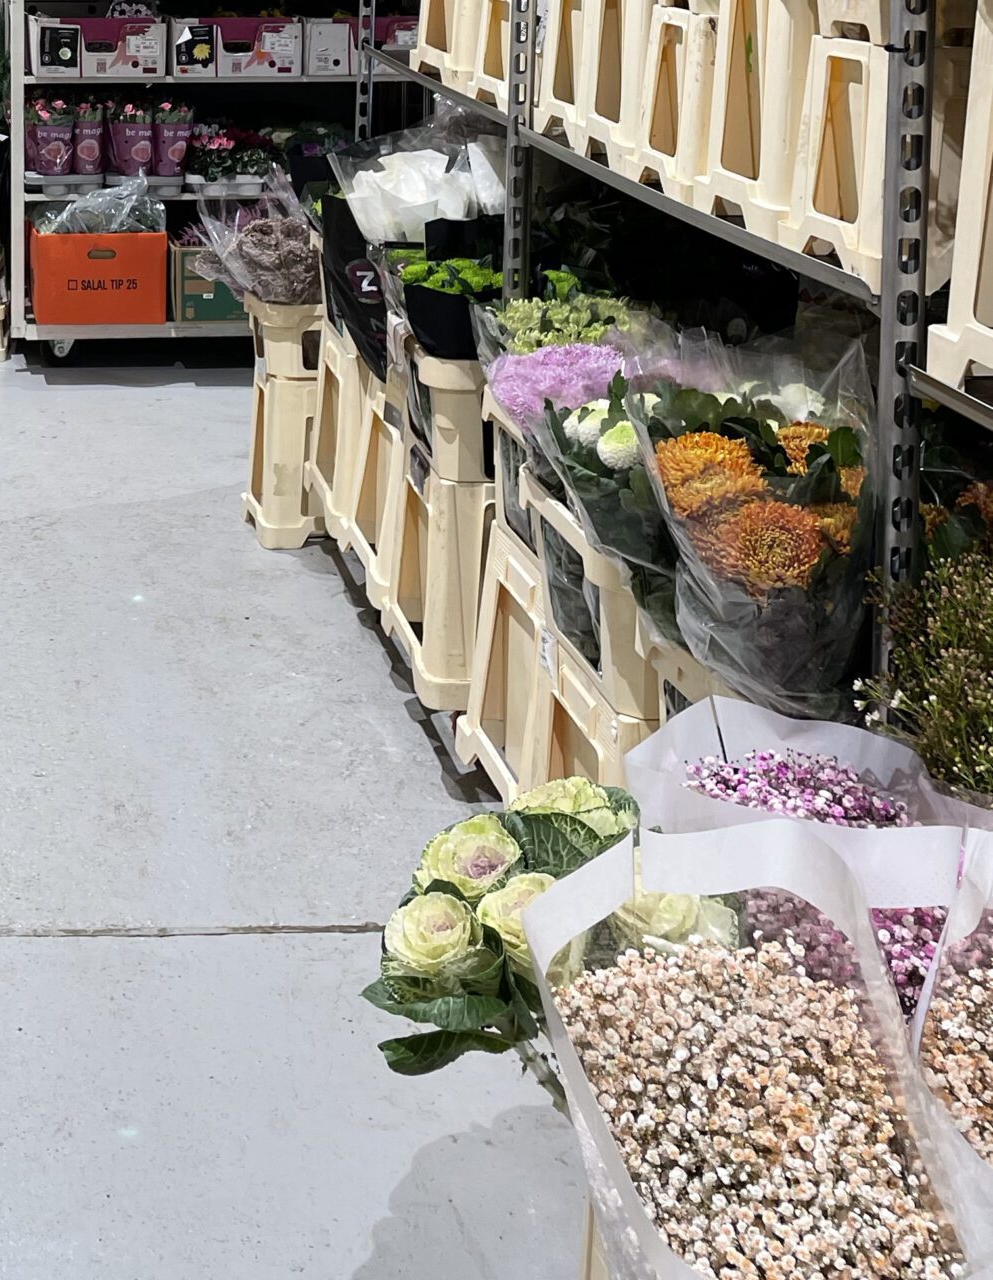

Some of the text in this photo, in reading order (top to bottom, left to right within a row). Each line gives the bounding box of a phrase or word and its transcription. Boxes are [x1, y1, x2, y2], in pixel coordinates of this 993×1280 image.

[81, 278, 138, 291] SALAL TIP 25
